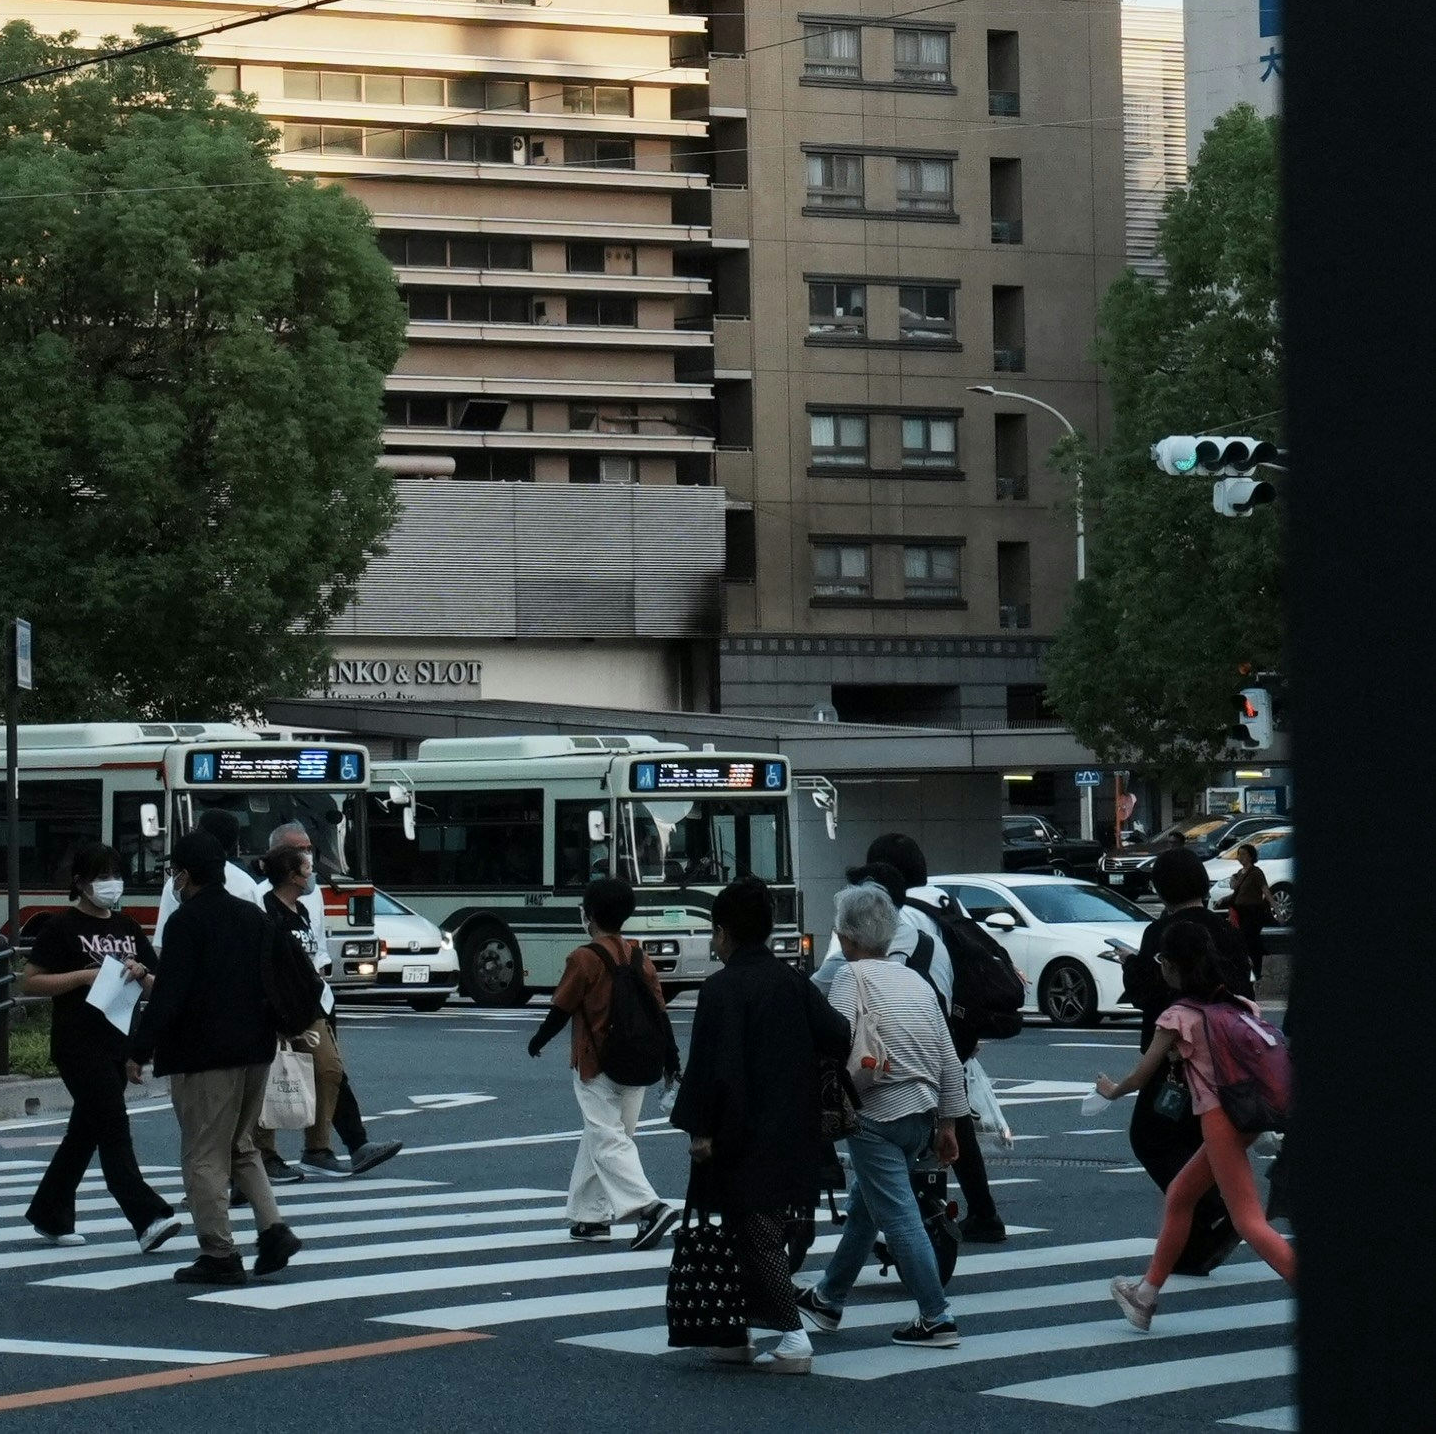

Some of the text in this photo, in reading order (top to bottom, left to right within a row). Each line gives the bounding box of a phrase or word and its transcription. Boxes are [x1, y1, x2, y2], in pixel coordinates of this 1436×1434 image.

[395, 664, 411, 684] &
[416, 660, 483, 684] SLOT
[77, 934, 138, 955] Mardi
